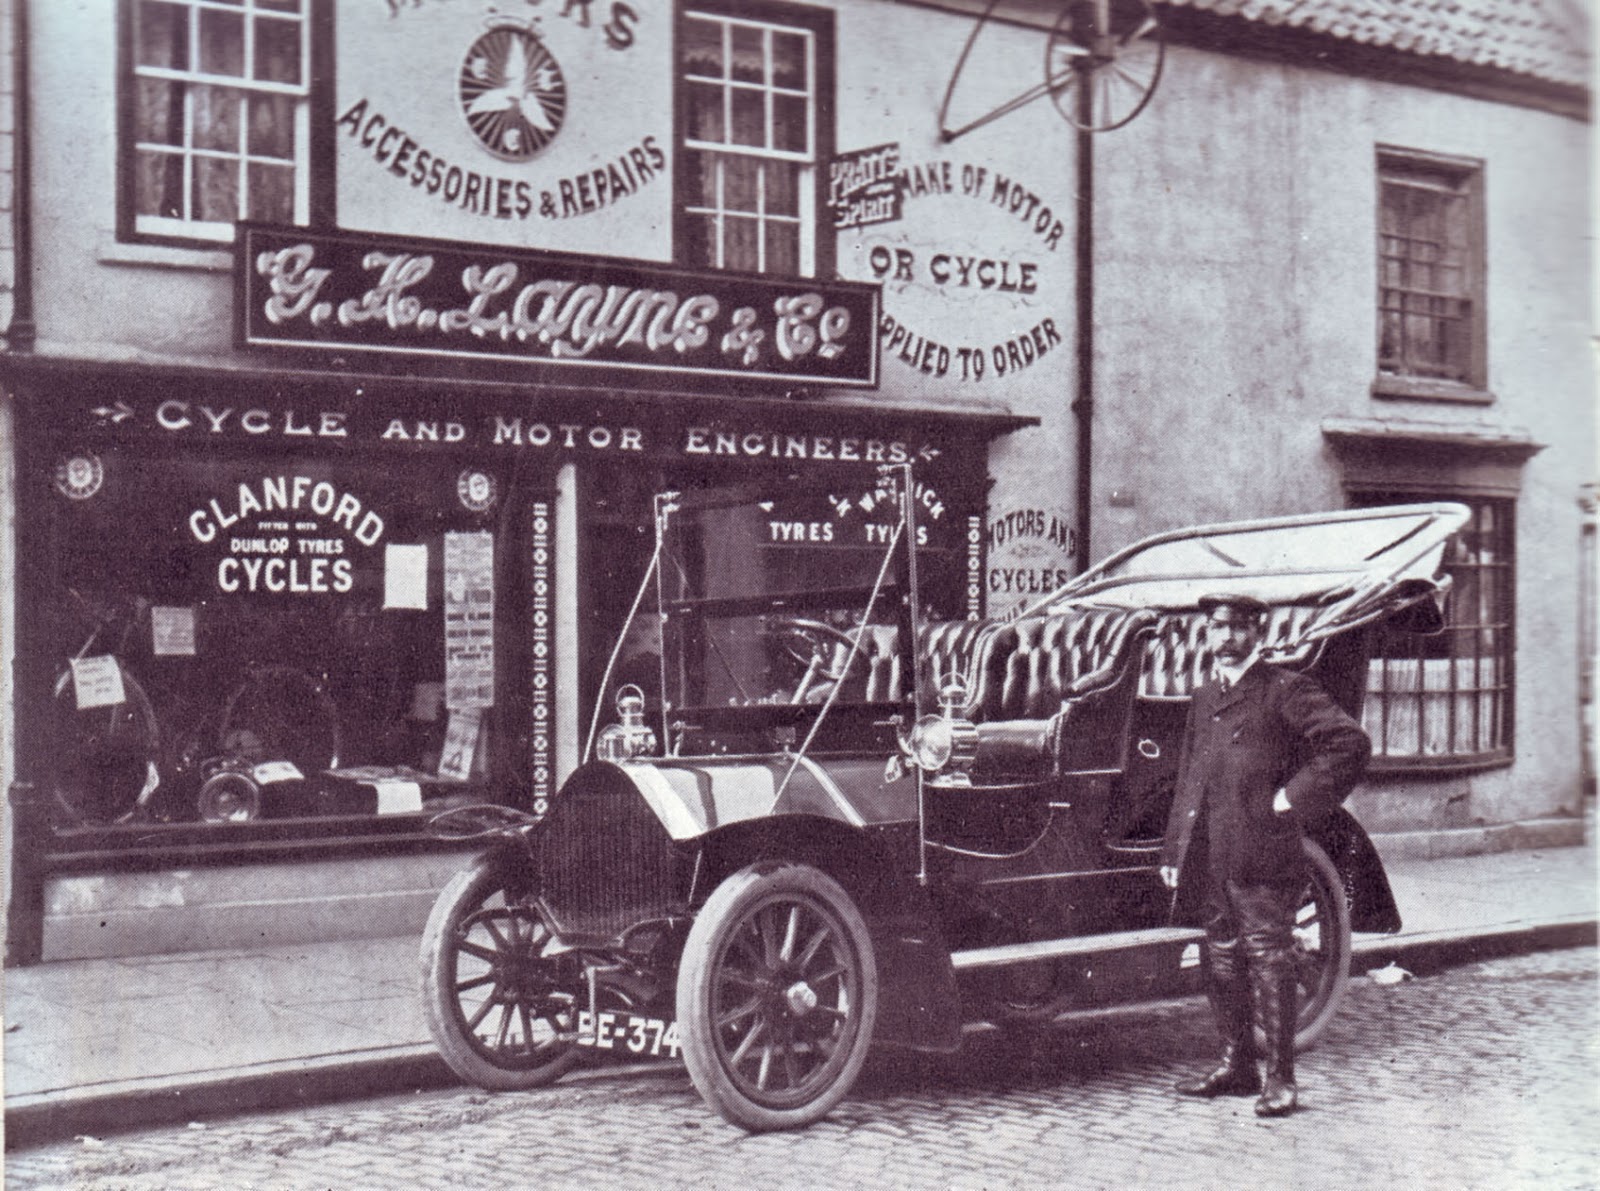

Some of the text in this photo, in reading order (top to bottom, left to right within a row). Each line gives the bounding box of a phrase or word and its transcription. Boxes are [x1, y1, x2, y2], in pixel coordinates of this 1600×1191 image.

[336, 99, 532, 220] ACCESSORIES
[539, 190, 556, 219] &
[558, 136, 666, 219] REPAIRS
[962, 163, 988, 198] OF
[990, 173, 1065, 251] MOTOR
[870, 245, 1038, 294] OR CYCLE
[720, 307, 766, 366] &
[880, 314, 1062, 382] PPLIED TO ORDER
[156, 400, 348, 437] CYCLE
[382, 418, 466, 443] AND
[493, 417, 643, 451] MOTOR
[188, 476, 385, 547] CLANFORD
[770, 521, 834, 542] TYRES
[865, 524, 929, 546] TYS
[230, 537, 344, 554] DUNLOP TYRES
[1048, 515, 1076, 559] AND
[217, 557, 354, 593] CYCLES
[989, 568, 1067, 594] CYCLES
